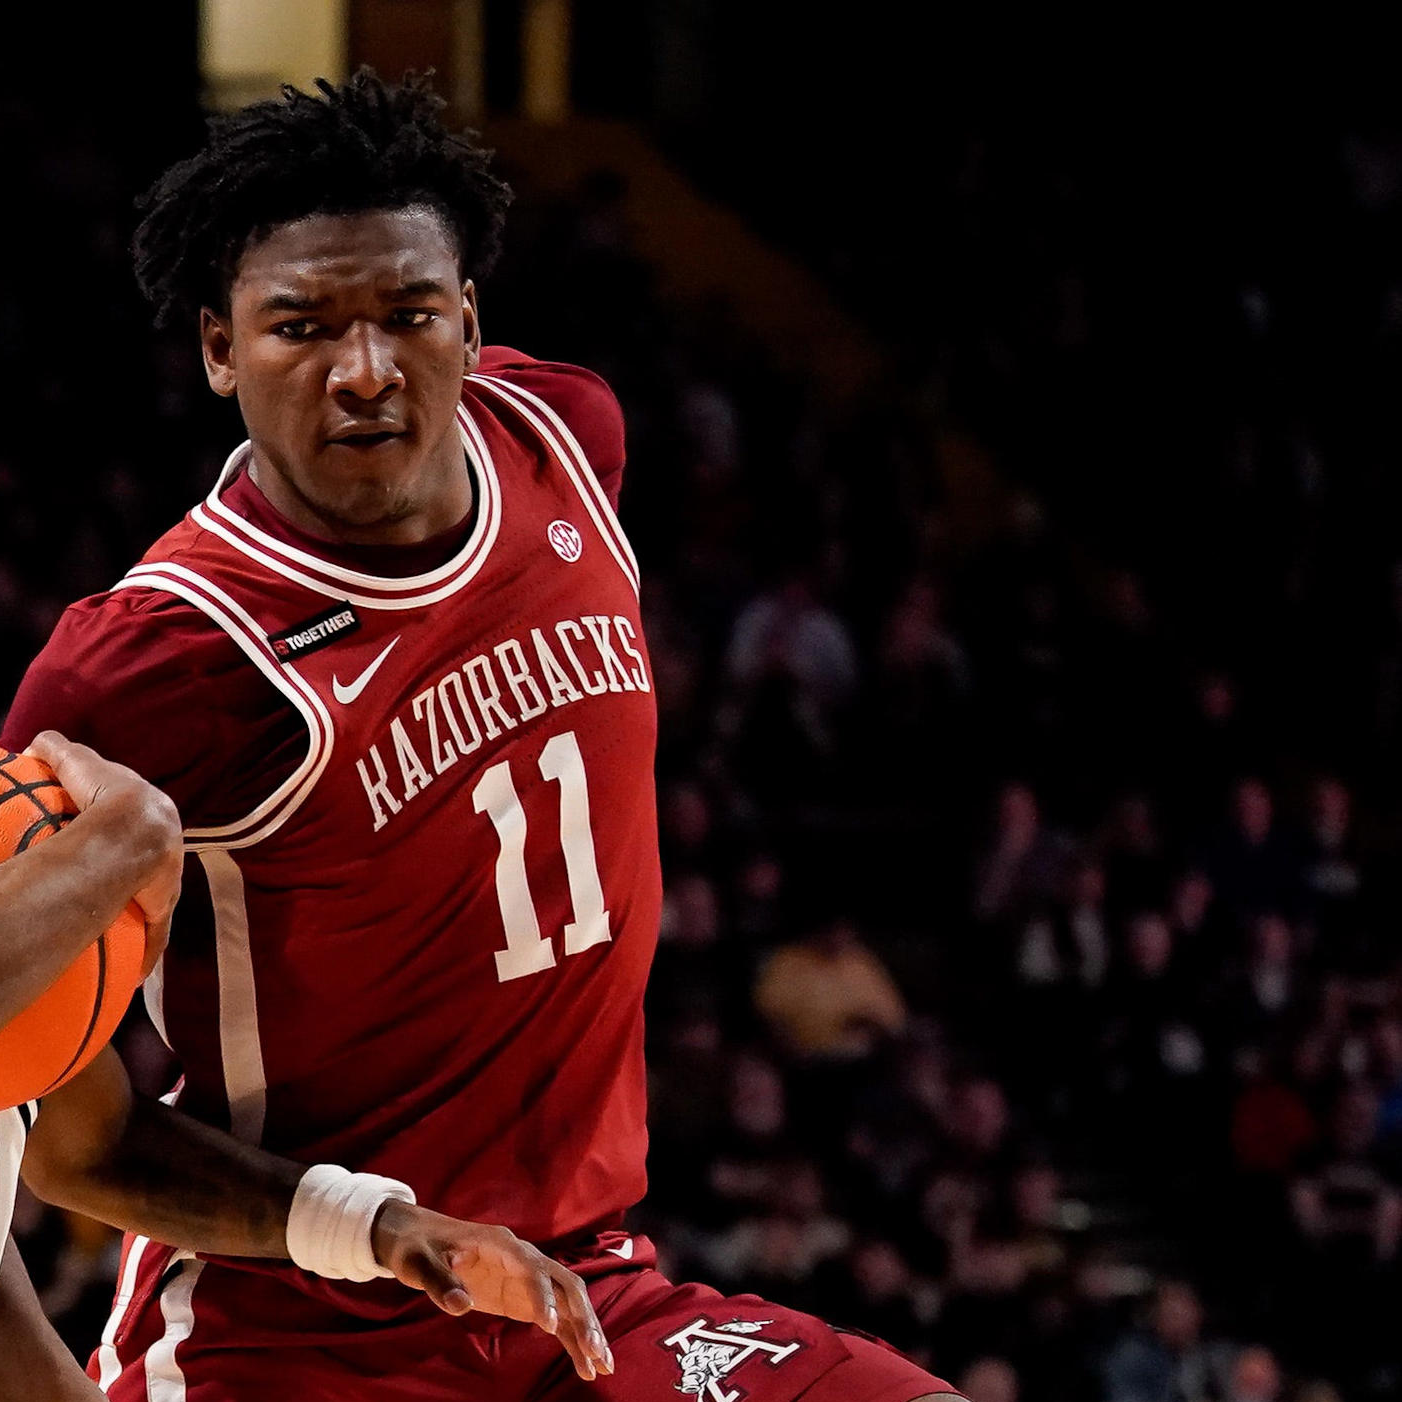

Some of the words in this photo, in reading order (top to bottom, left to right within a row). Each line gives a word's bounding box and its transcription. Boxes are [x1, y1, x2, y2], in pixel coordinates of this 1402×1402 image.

[550, 523, 579, 559] SEC
[285, 610, 356, 651] TOGETHER
[356, 615, 652, 833] RAZORBACKS
[472, 730, 613, 983] 11
